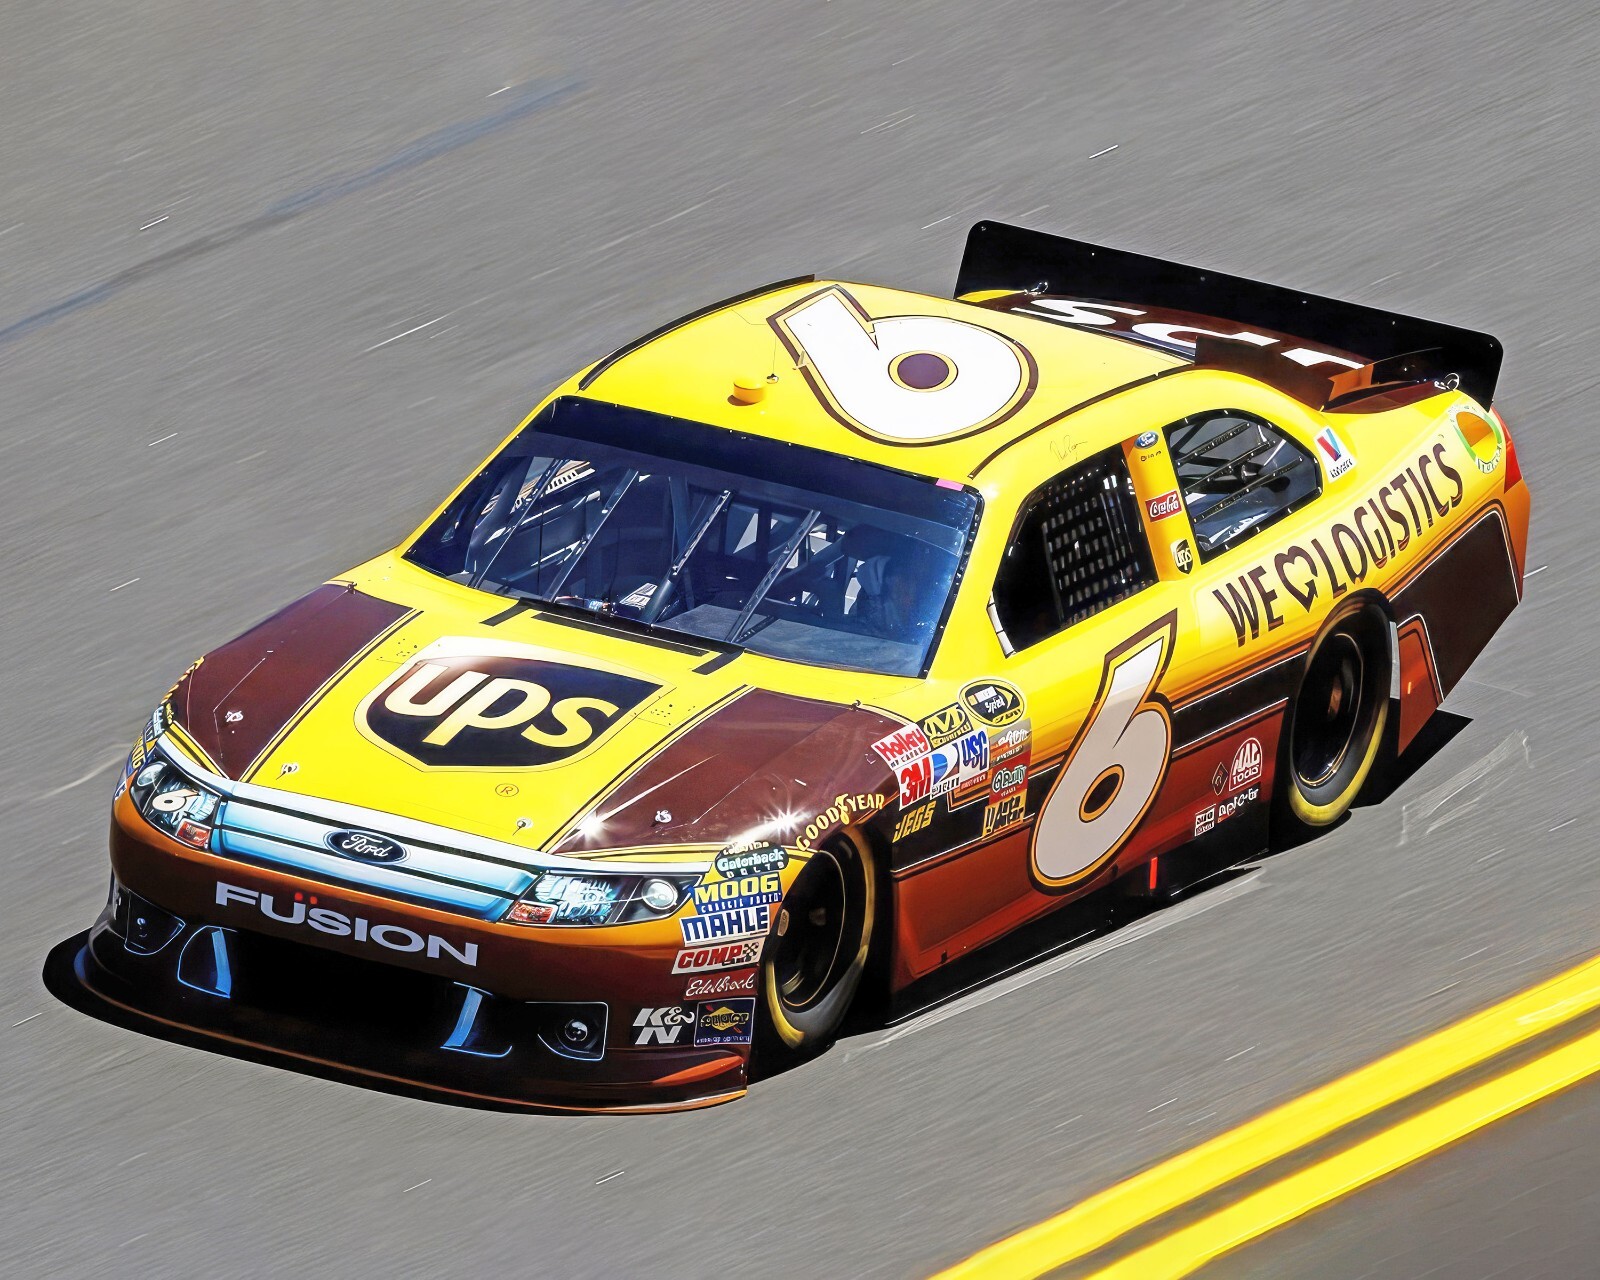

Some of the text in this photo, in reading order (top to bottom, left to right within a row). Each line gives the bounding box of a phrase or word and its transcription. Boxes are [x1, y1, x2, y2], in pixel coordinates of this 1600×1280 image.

[767, 285, 1039, 448] 6
[1211, 442, 1464, 648] WE LOGISTICS
[874, 728, 930, 762] Holley
[1027, 608, 1178, 897] 6
[900, 757, 931, 807] 3M
[892, 800, 937, 844] JEGS
[341, 831, 390, 859] Ford
[694, 873, 779, 905] MOOG
[215, 881, 478, 967] FUSION
[681, 907, 769, 942] MAHLE
[677, 945, 743, 969] COMP
